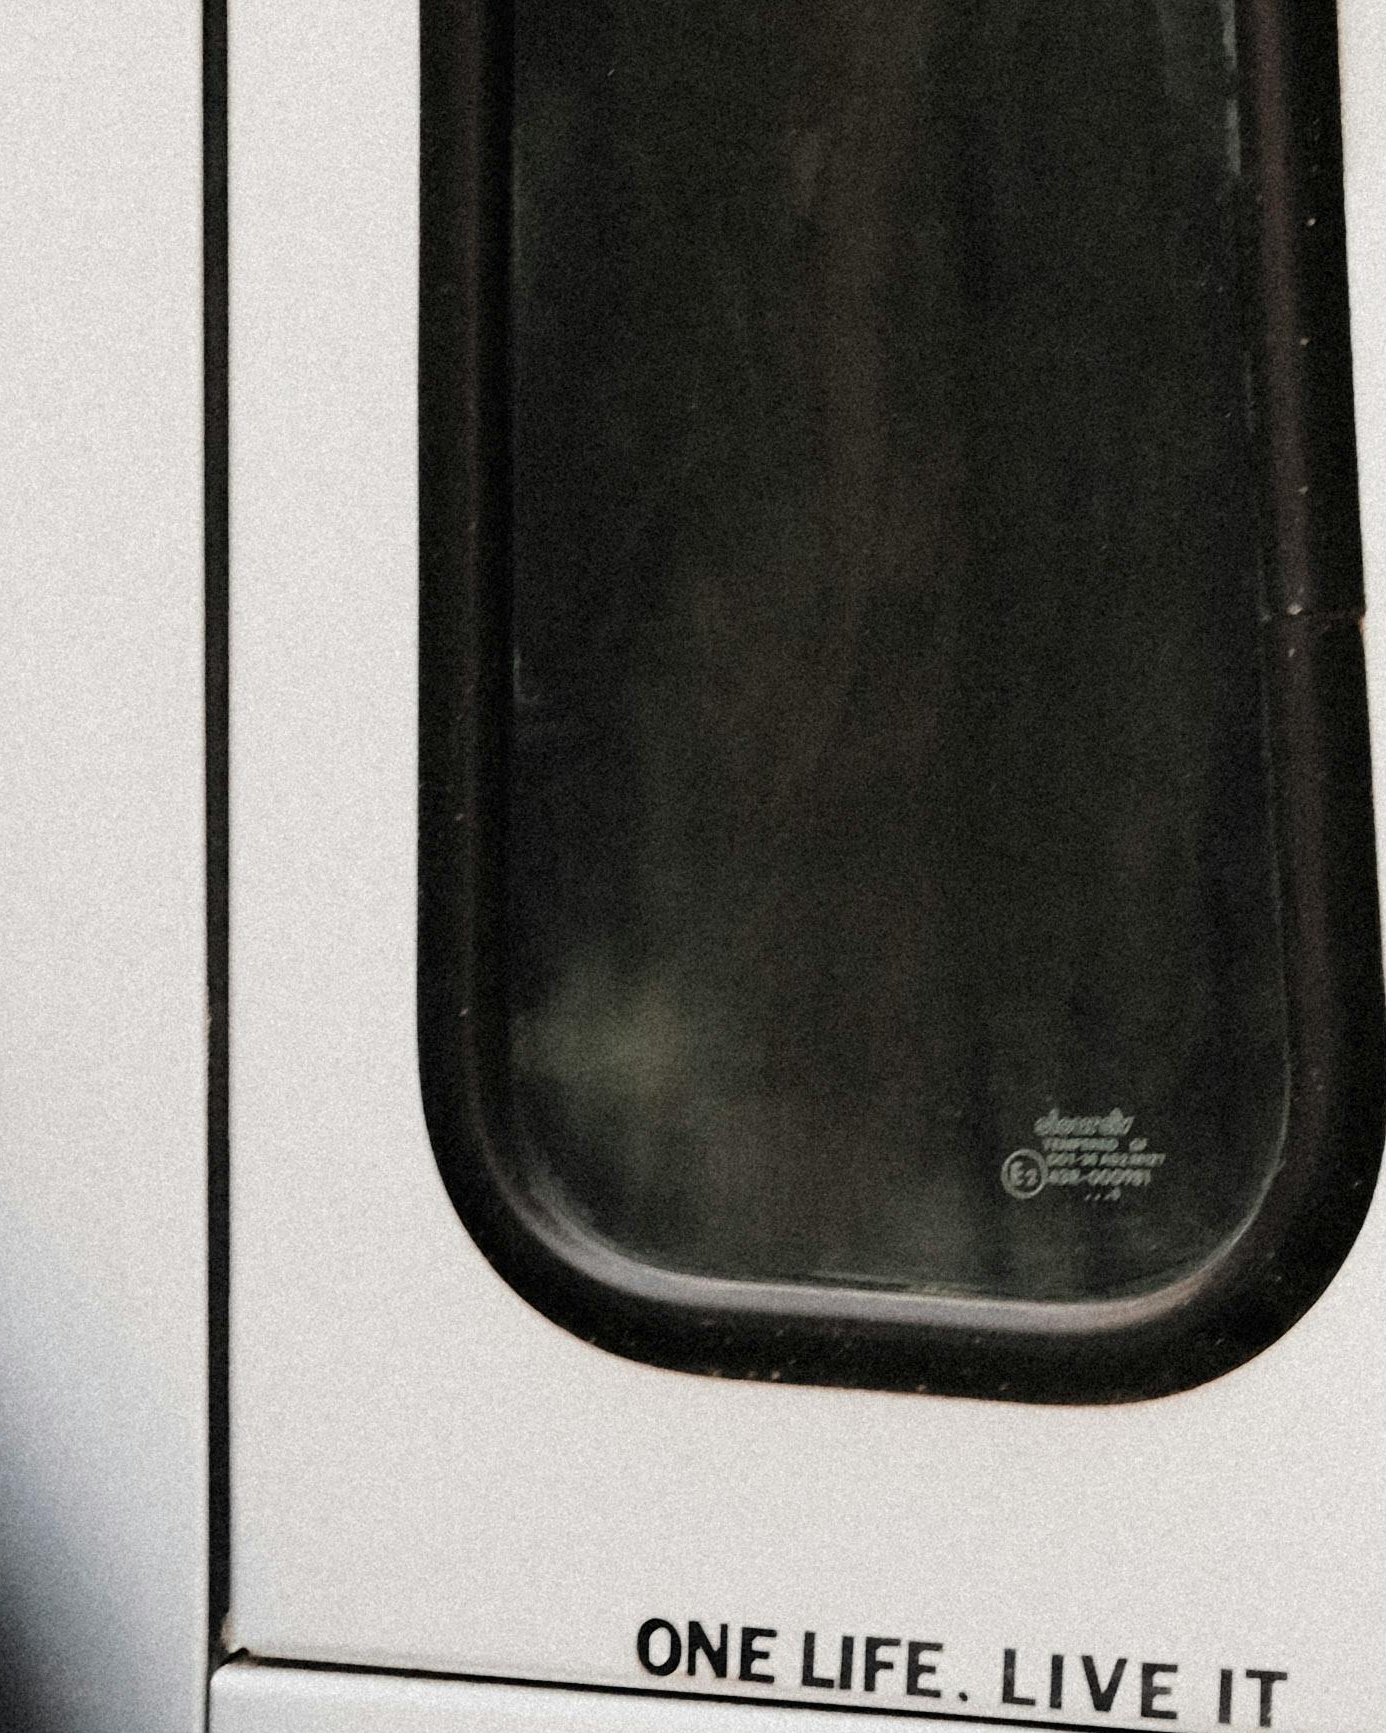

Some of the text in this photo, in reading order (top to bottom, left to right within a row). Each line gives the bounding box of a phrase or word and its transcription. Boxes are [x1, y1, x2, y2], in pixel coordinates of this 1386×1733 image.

[635, 1617, 1289, 1728] ONE LIFE. LIVE IT
